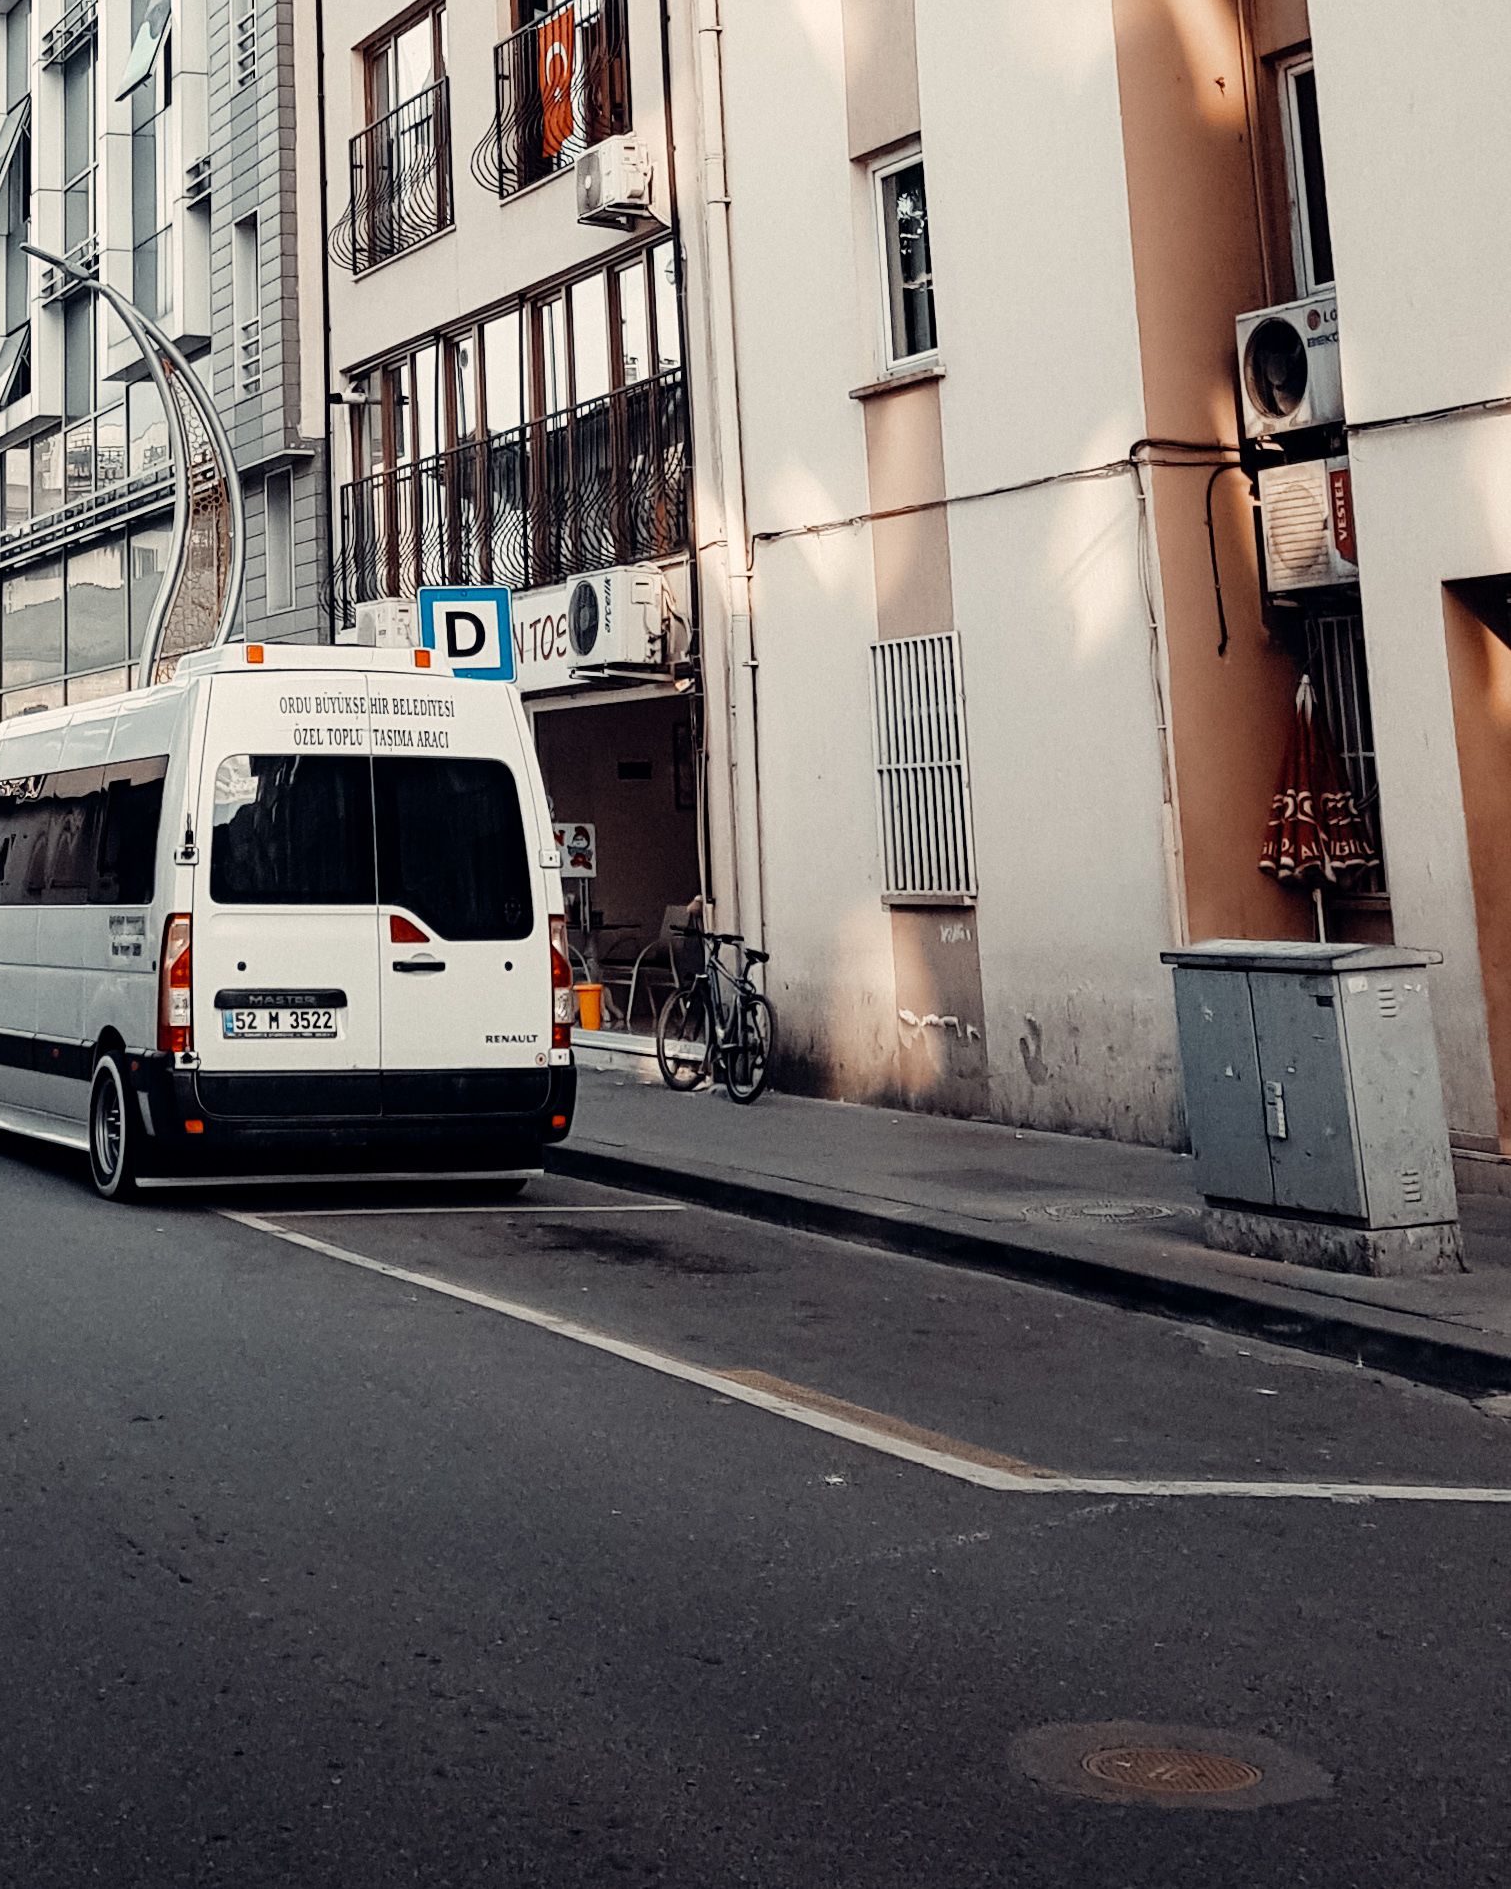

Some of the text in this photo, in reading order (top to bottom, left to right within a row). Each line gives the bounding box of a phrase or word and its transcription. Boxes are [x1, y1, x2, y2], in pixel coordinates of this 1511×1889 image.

[1334, 477, 1348, 541] VESTEL
[445, 611, 486, 658] D
[279, 696, 312, 714] ORDU
[392, 694, 455, 718] BELEDİYESİ
[293, 723, 324, 746] ÖZEL
[326, 728, 363, 746] TOPLU
[416, 730, 449, 749] ARACI
[248, 995, 317, 1006] MASTER
[235, 1011, 333, 1030] 52 M 3522
[485, 1034, 539, 1044] RENAULT
